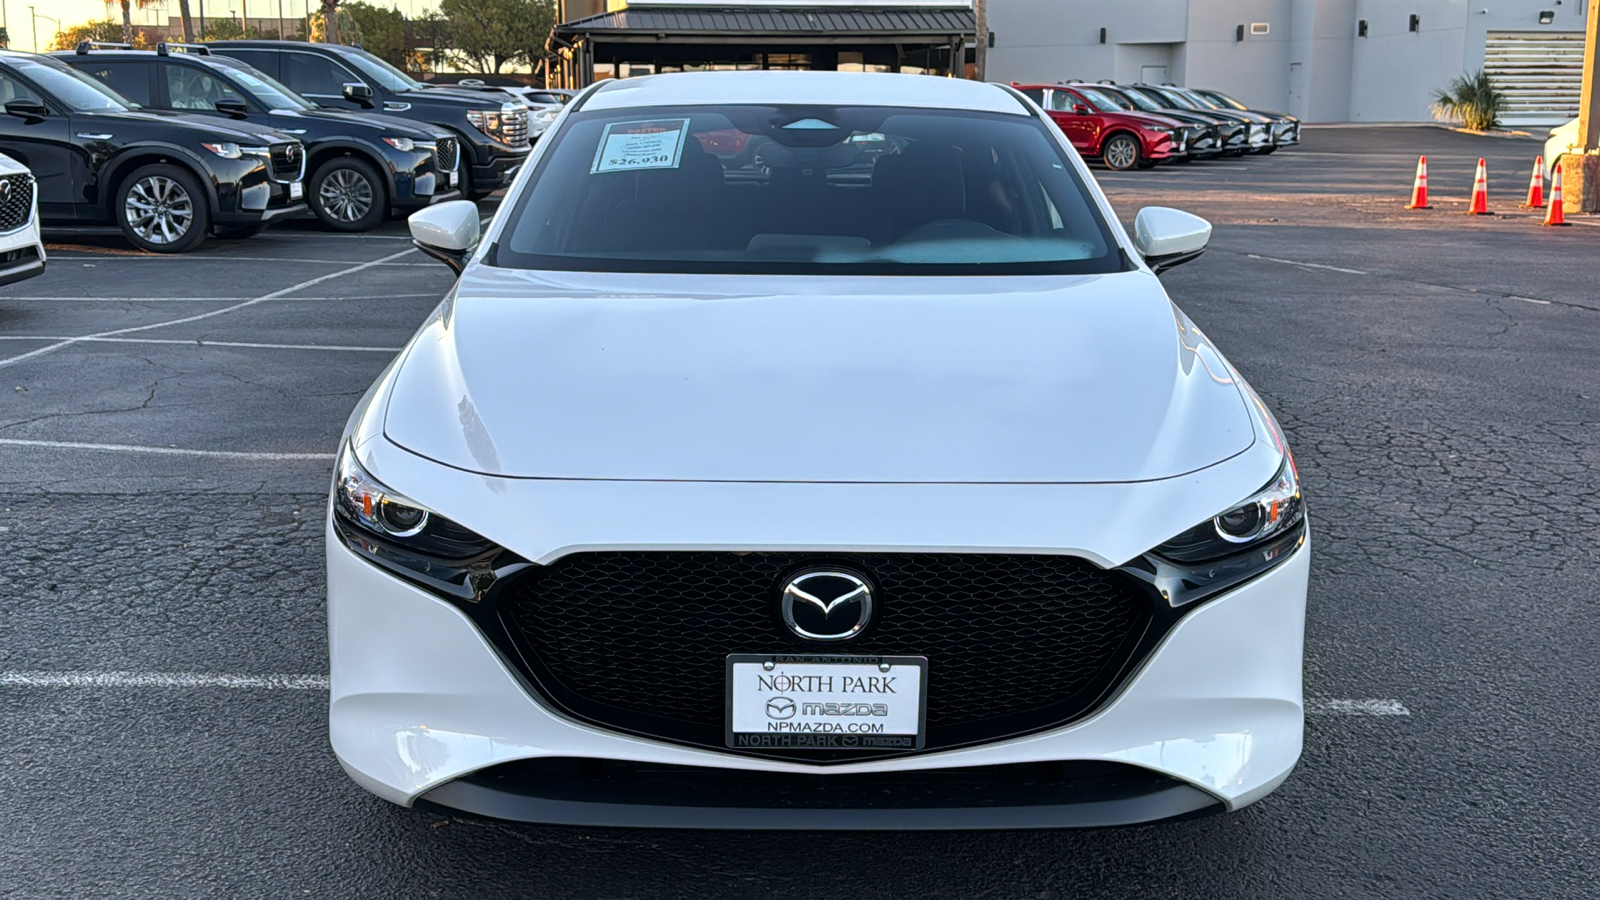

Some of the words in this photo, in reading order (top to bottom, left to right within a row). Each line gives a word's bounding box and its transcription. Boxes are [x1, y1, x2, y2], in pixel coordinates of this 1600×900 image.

[775, 656, 806, 664] SAN
[811, 656, 879, 664] ANTONIO
[757, 674, 833, 693] NORTH
[842, 676, 897, 694] PARK
[802, 702, 889, 717] mazda
[767, 722, 884, 733] NPMAZDA.COM
[738, 735, 792, 747] NORTH
[797, 735, 838, 747] PARK
